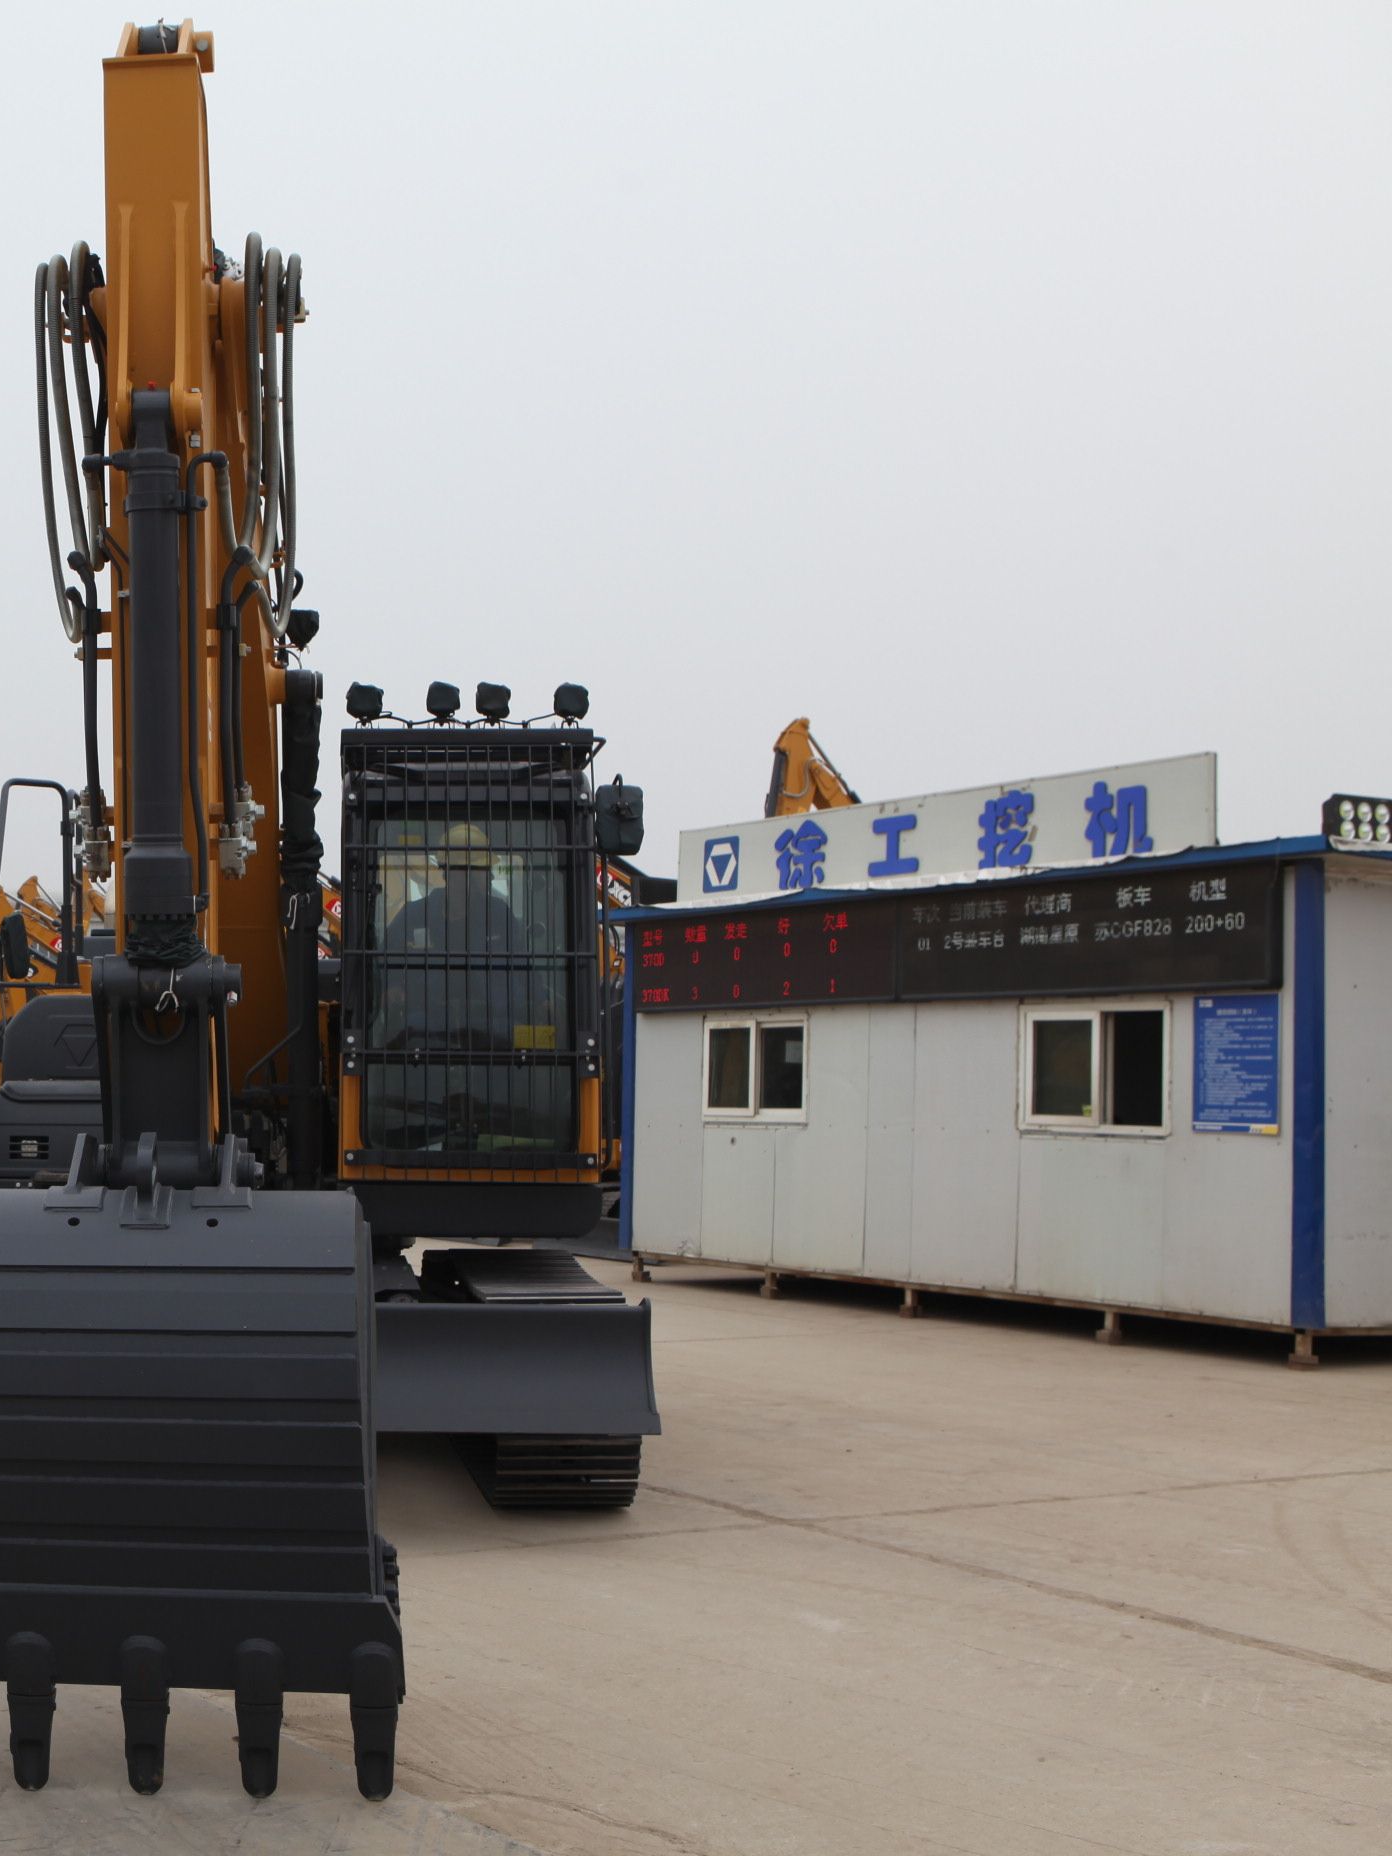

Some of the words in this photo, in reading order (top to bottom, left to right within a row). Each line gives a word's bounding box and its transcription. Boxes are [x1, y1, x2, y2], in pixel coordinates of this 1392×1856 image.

[774, 781, 1154, 890] 徐工挖机
[1024, 892, 1073, 917] 代理商
[1116, 885, 1152, 908] 板车
[1189, 878, 1227, 902] 机型
[1185, 911, 1245, 934] 200+60
[642, 930, 664, 948] 型号
[783, 942, 791, 958] 0
[732, 983, 741, 999] 0
[782, 981, 791, 996] 2
[831, 978, 837, 993] 1
